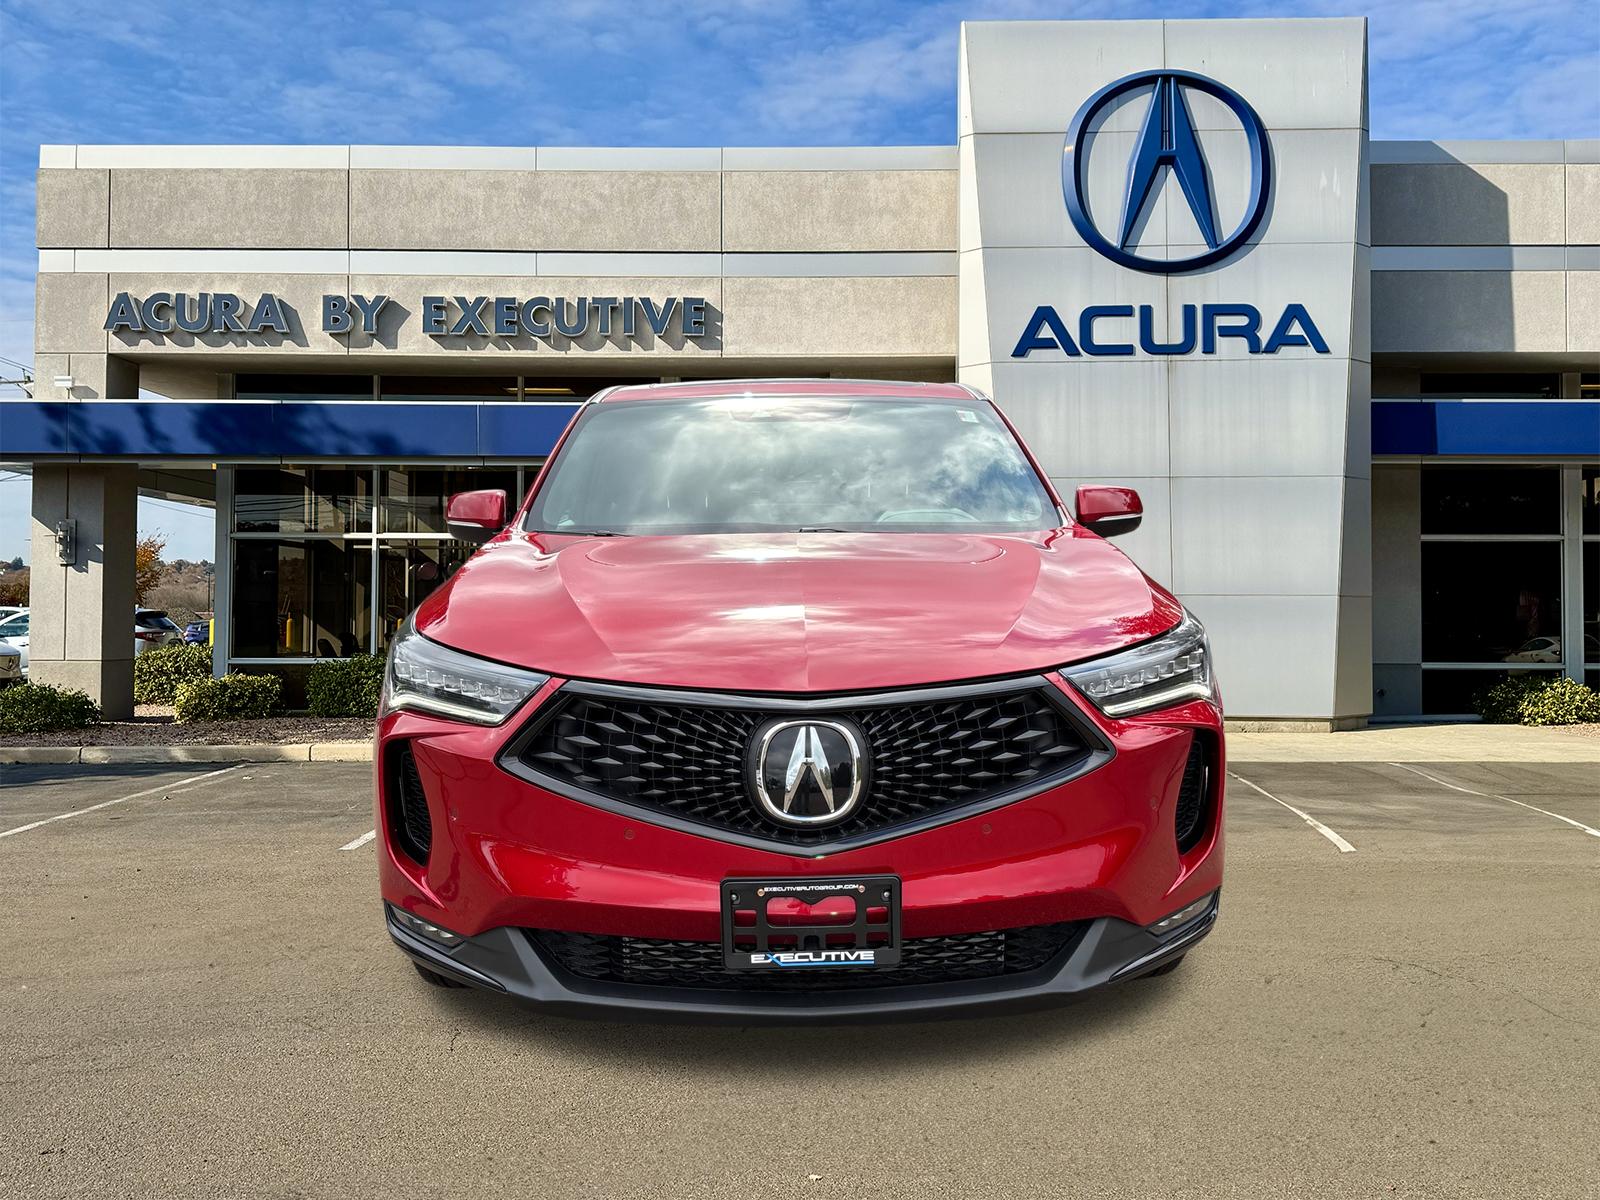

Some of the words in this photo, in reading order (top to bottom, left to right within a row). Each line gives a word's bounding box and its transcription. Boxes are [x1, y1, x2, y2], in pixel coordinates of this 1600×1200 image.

[104, 291, 289, 334] ACURA
[322, 294, 391, 335] BY
[422, 296, 706, 337] EXECUTIVE
[1010, 303, 1331, 357] ACURA
[764, 884, 859, 892] EXECUTIVEAUTOGROUP.COM
[750, 950, 875, 966] EXECUTIVE
